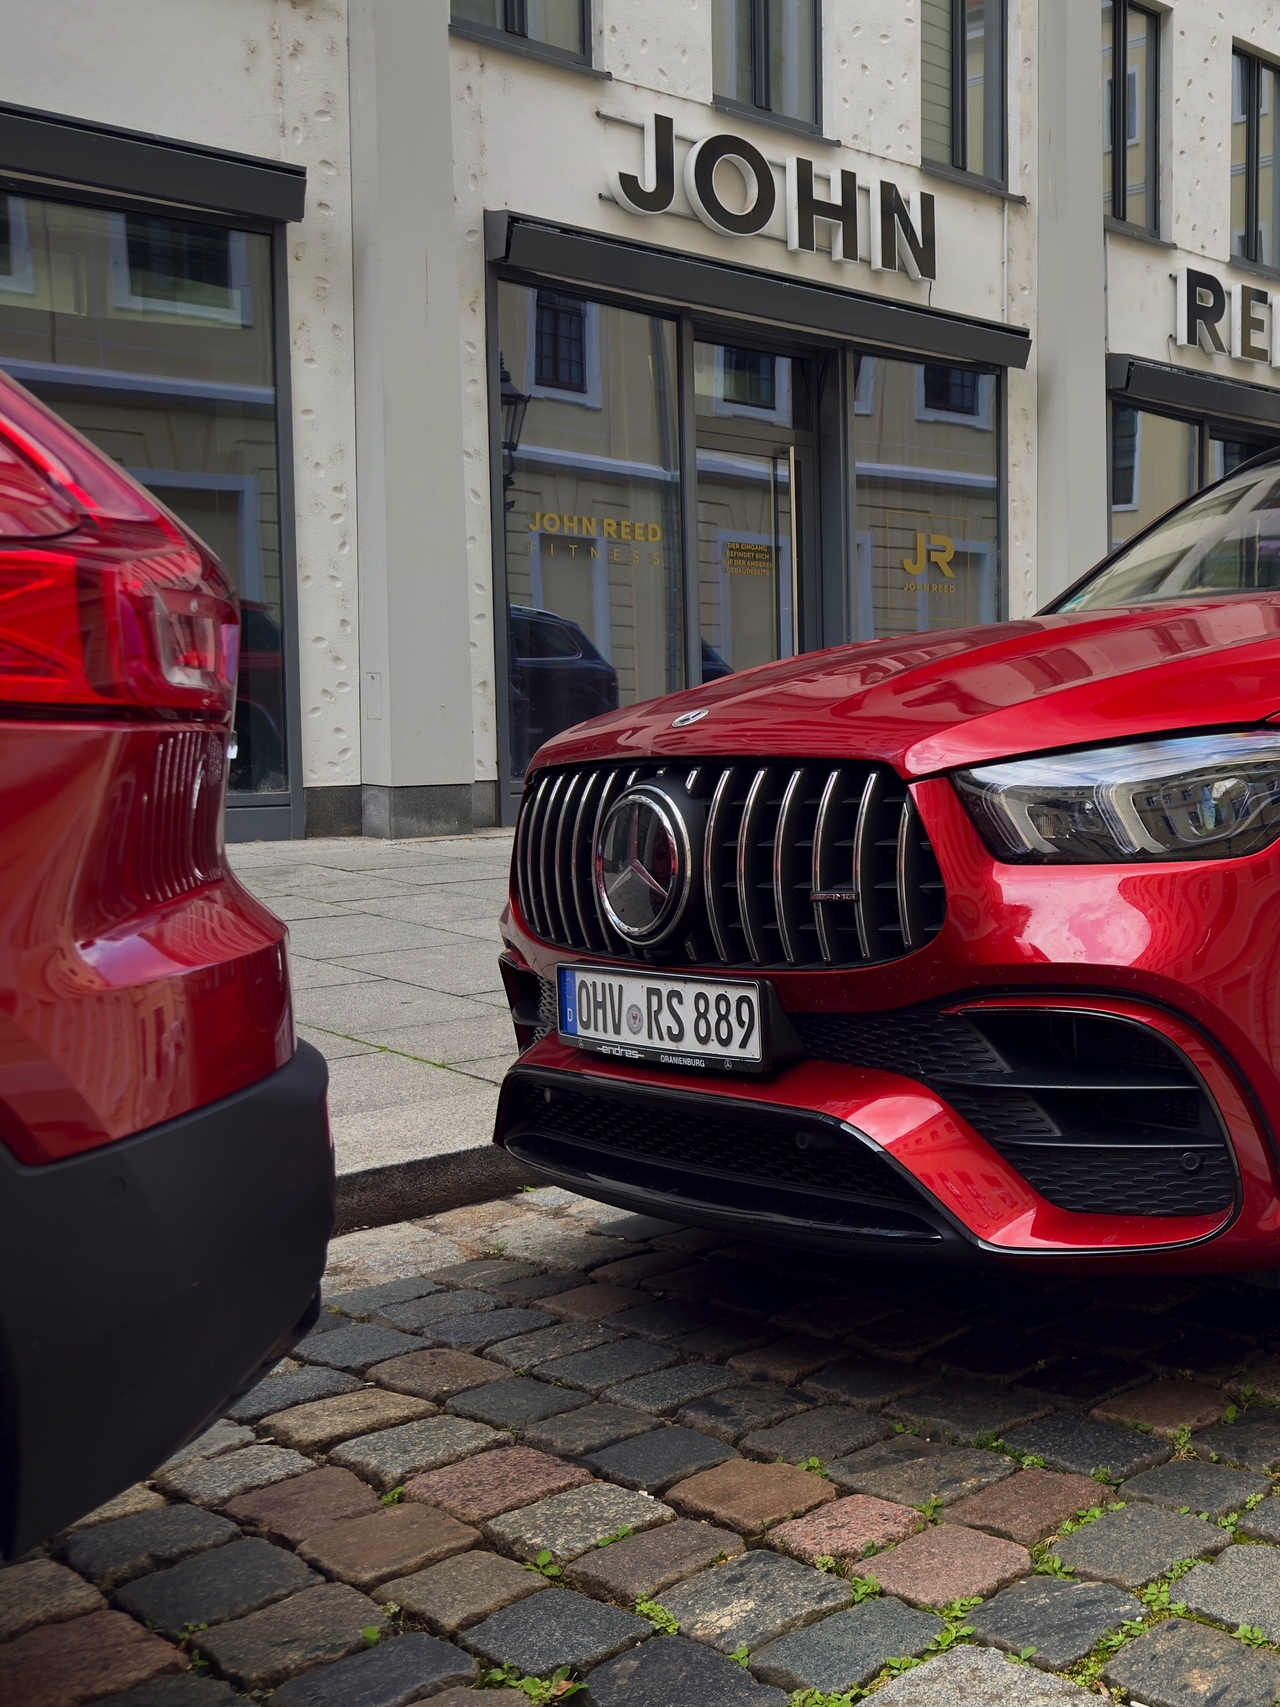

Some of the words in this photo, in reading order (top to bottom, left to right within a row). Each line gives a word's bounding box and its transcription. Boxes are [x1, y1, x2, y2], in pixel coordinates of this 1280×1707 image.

[611, 112, 937, 282] JOHN
[528, 511, 597, 536] JOHN
[603, 518, 661, 541] REED
[529, 541, 660, 565] FITNESS
[726, 550, 755, 559] BEFINDET
[741, 544, 768, 552] EINGANG
[902, 532, 956, 578] JR
[904, 582, 930, 592] JOHN
[932, 583, 956, 594] REED
[567, 1008, 573, 1022] D
[577, 979, 624, 1035] OHV
[646, 986, 685, 1043] RS
[693, 991, 755, 1049] 889
[660, 1054, 706, 1068] ORANIENBURG
